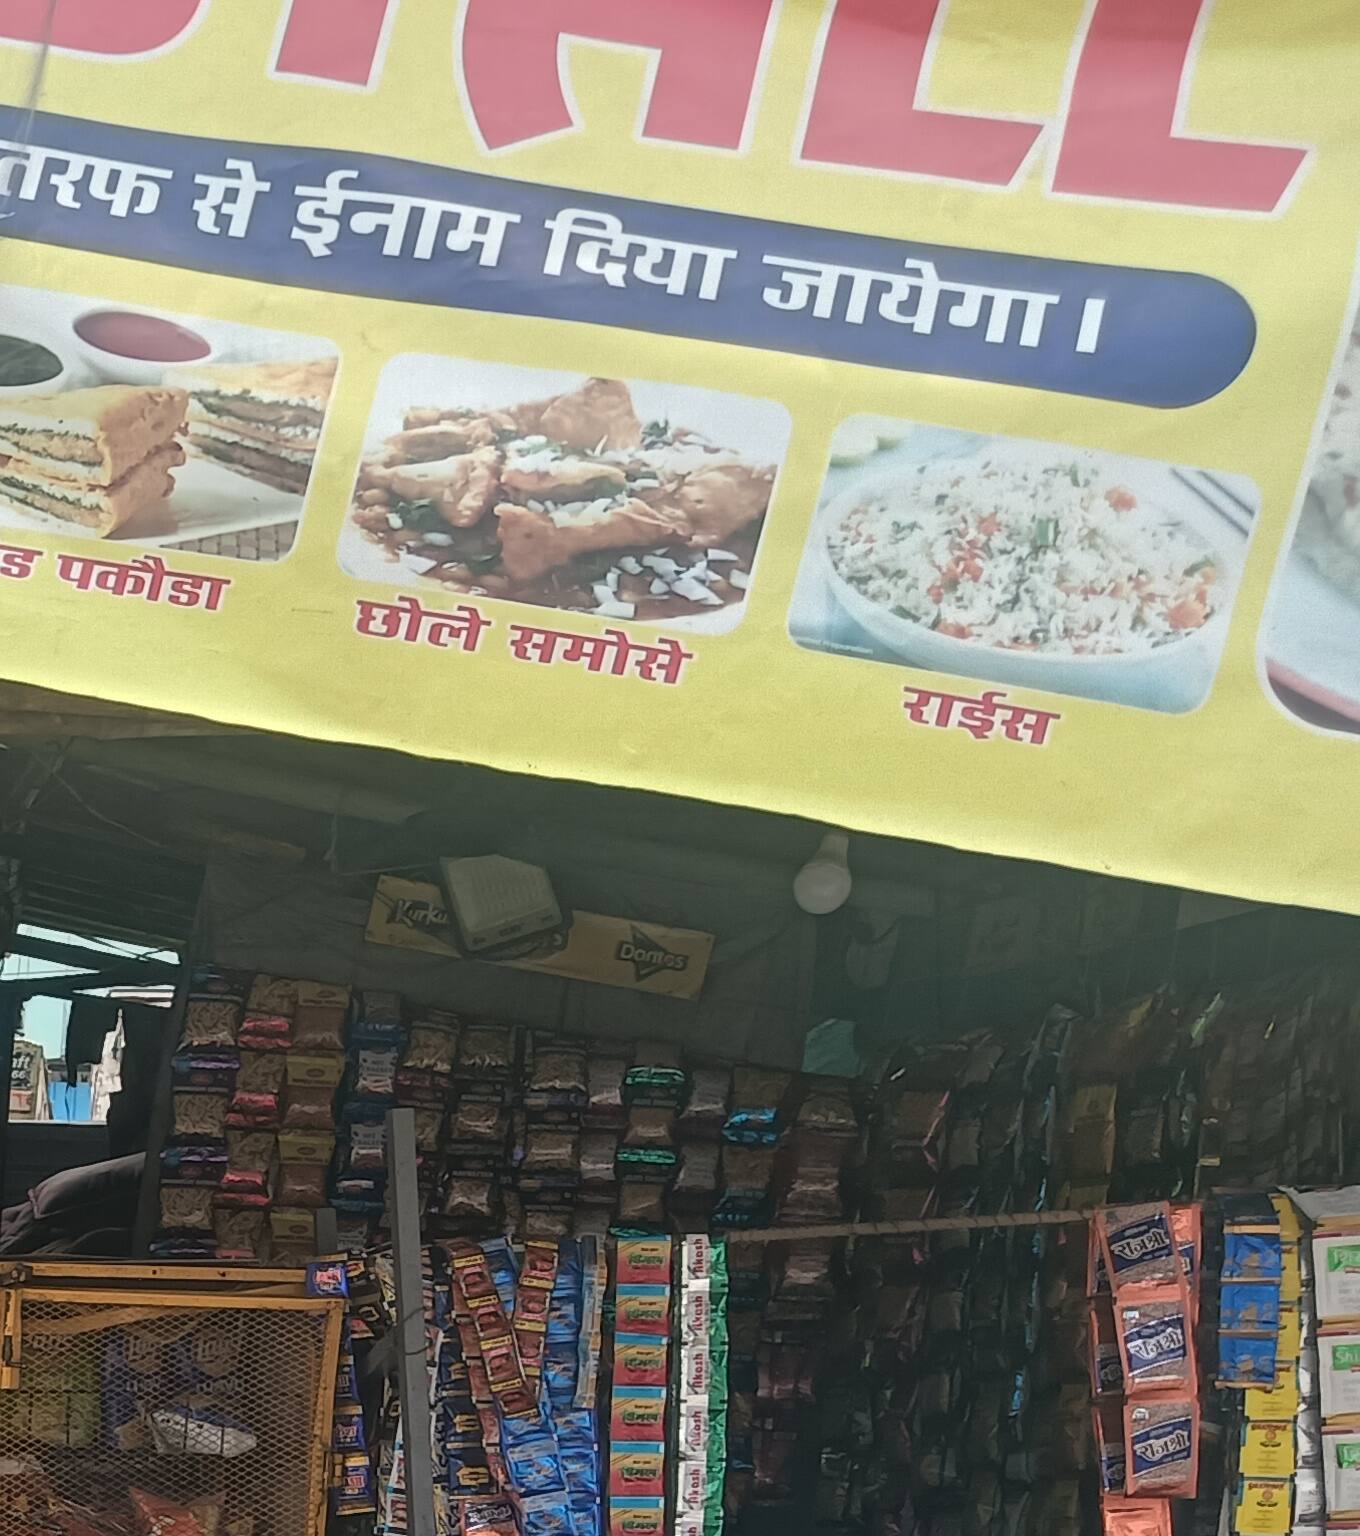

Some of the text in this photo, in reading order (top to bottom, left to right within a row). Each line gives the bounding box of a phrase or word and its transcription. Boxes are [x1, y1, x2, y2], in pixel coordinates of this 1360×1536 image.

[193, 158, 269, 238] से
[290, 170, 520, 268] ईनाम
[542, 207, 737, 301] दिया
[57, 552, 233, 611] पकौडा
[354, 594, 694, 686] छोले समोसे
[903, 683, 1061, 747] राईस
[393, 898, 449, 927] Kurku
